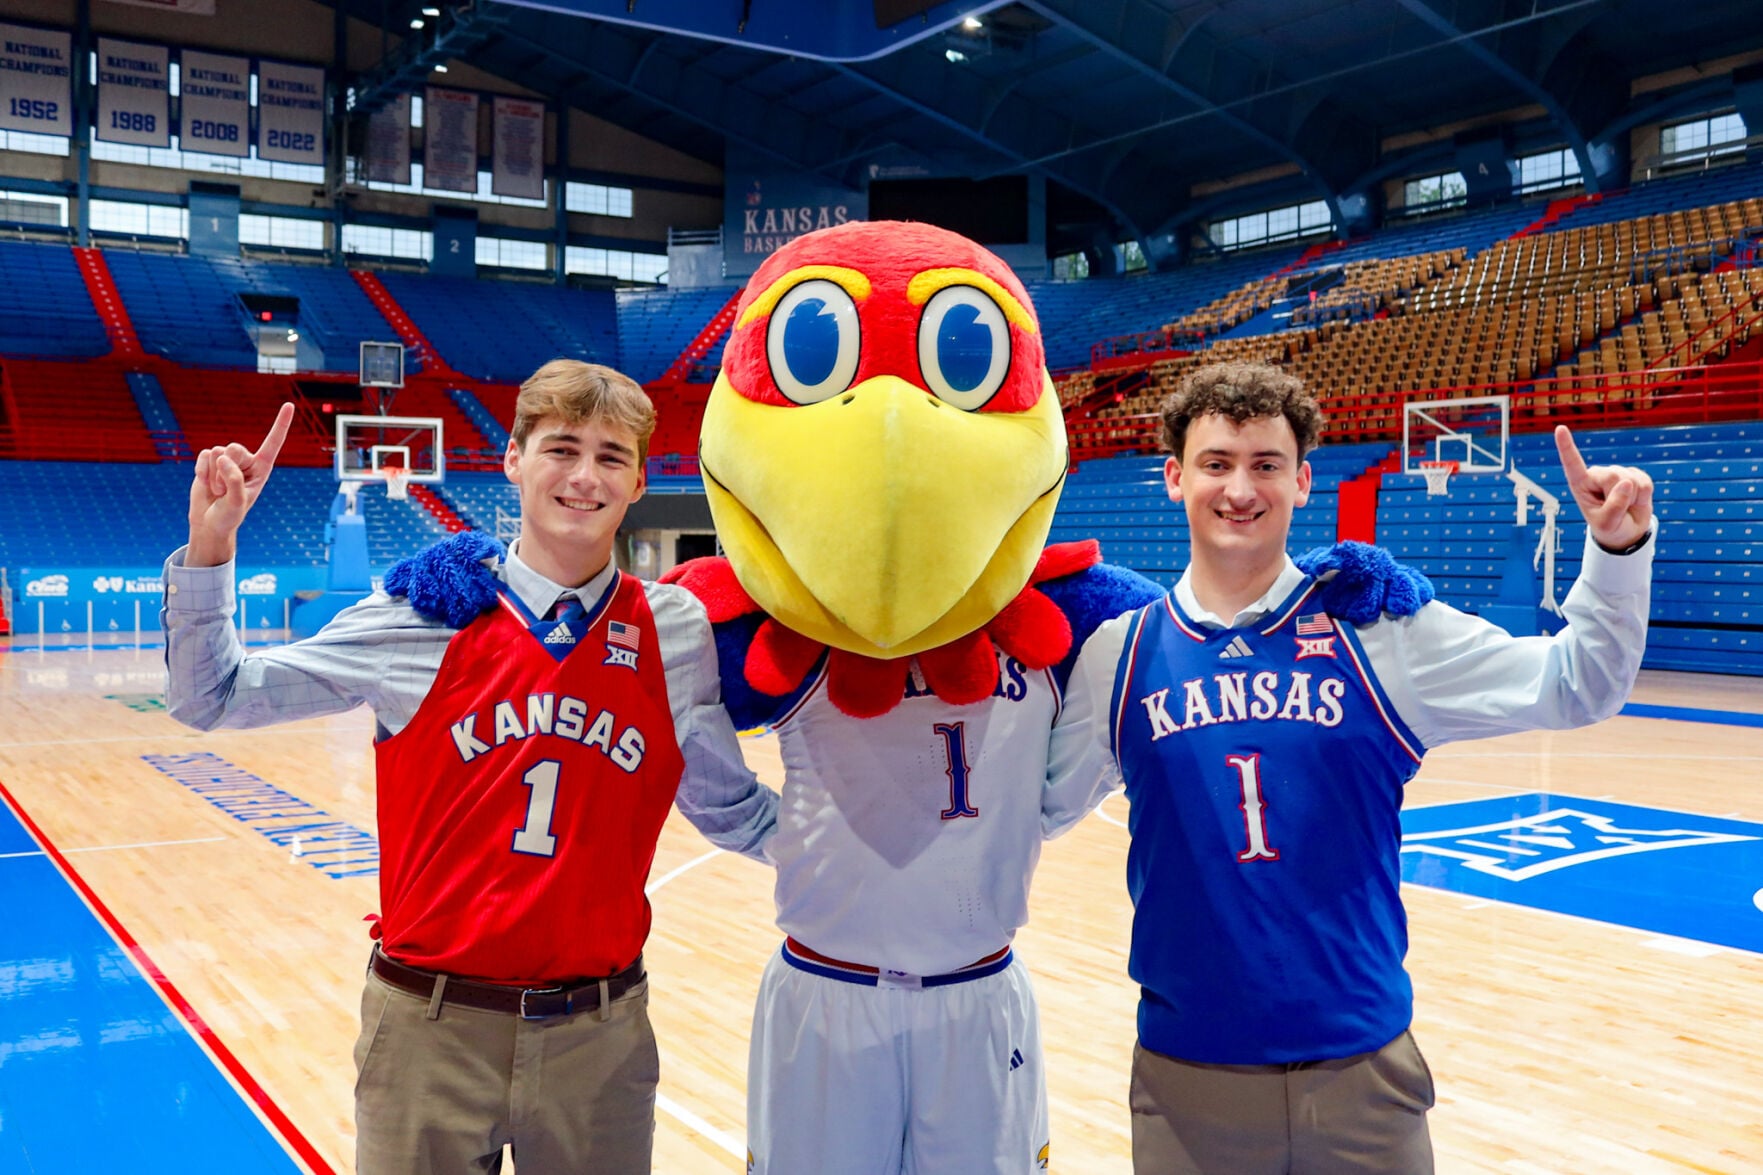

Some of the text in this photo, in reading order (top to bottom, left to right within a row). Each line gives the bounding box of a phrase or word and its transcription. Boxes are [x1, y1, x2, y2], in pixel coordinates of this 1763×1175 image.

[5, 41, 63, 60] NATIONAL
[0, 58, 69, 77] CHAMPIONS
[107, 56, 161, 74] NATIONAL
[190, 67, 242, 85] NATIONAL
[101, 71, 167, 90] CHAMPIONS
[183, 83, 247, 101] CHAMPIONS
[10, 97, 58, 121] 1952
[111, 110, 156, 133] 1988
[191, 119, 239, 142] 2008
[267, 129, 315, 151] 2022
[210, 217, 219, 233] 1
[744, 205, 848, 235] KANSAS
[449, 239, 460, 253] 2
[544, 634, 576, 645] adidas
[1294, 636, 1337, 662] XII
[602, 644, 639, 672] XII
[1140, 671, 1346, 741] KANSAS
[450, 693, 646, 774] KANSAS
[933, 721, 979, 820] 1
[511, 757, 563, 858] 1
[1225, 752, 1280, 863] 1
